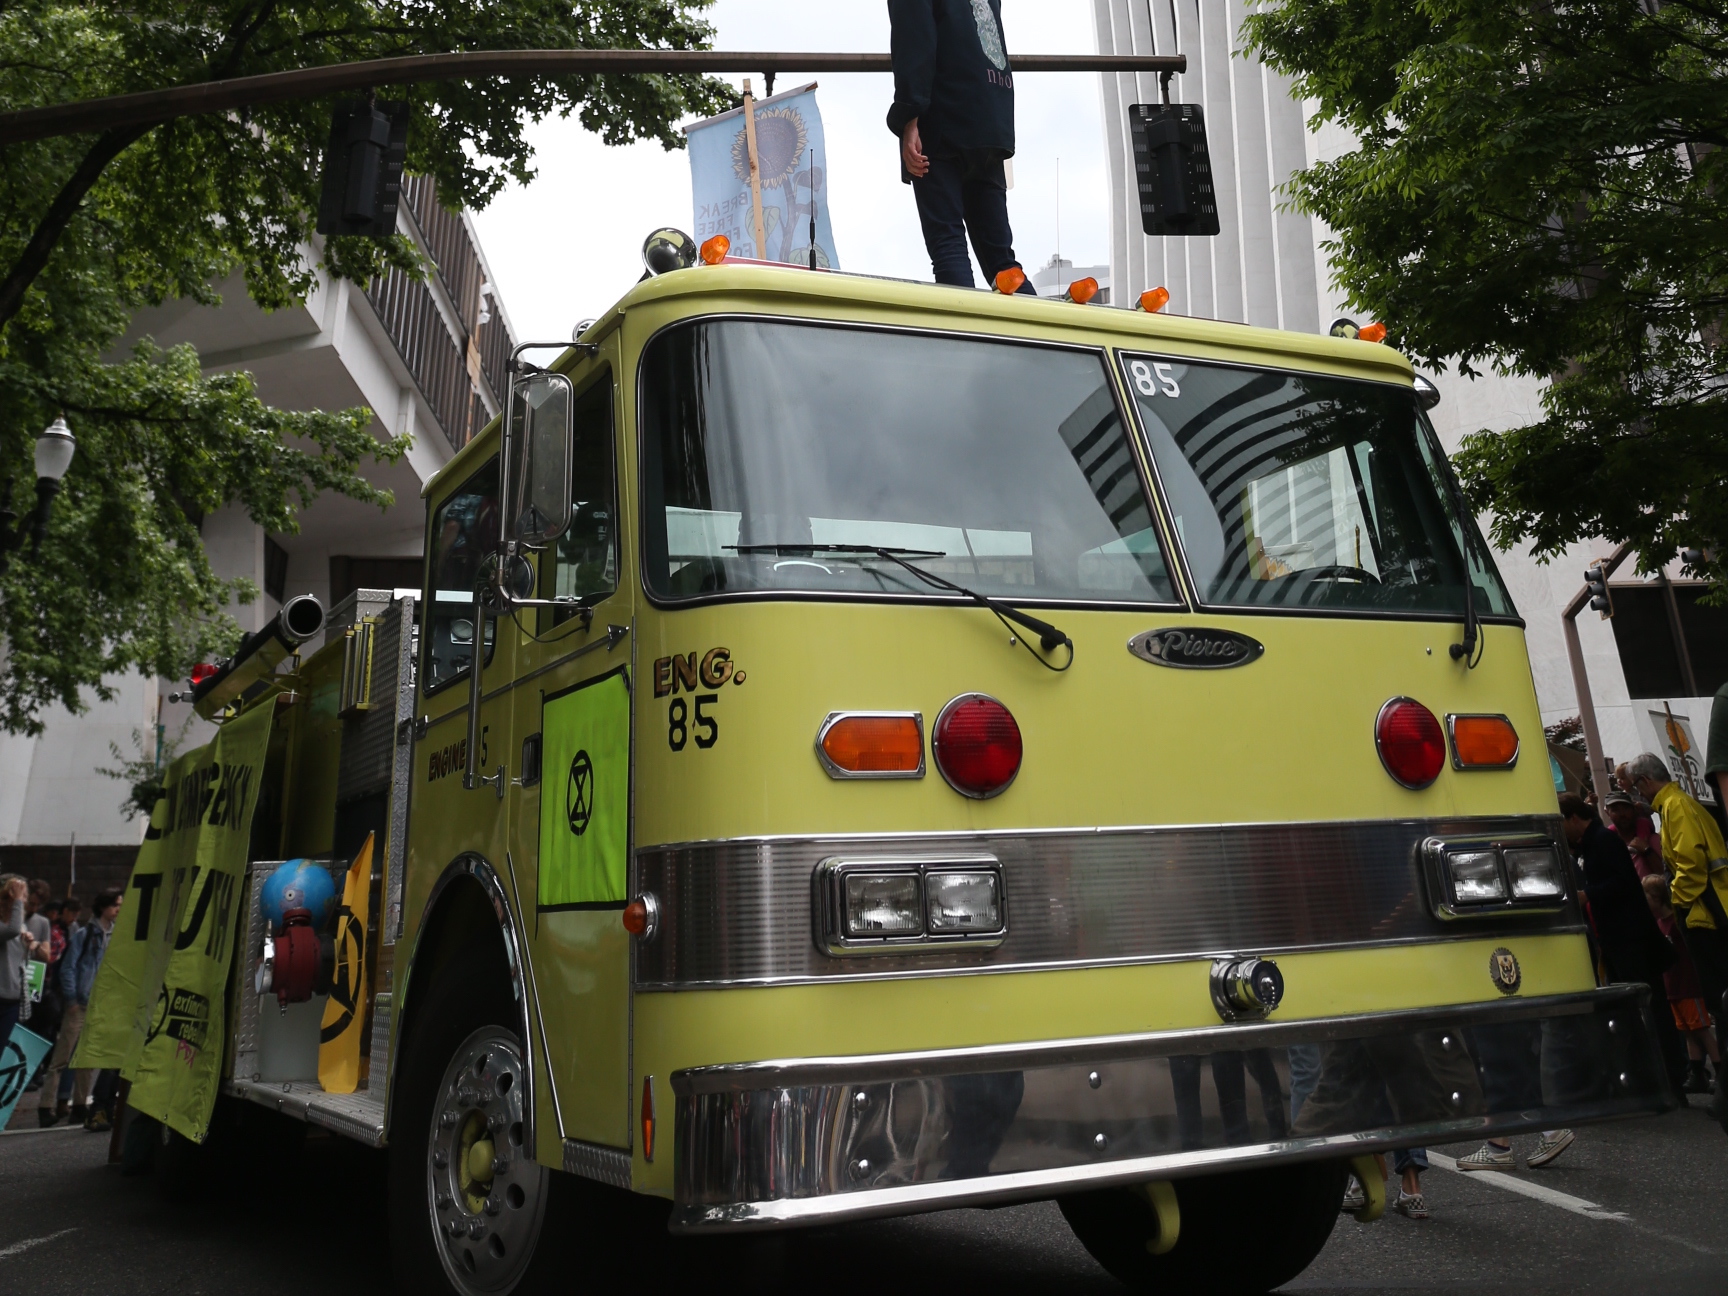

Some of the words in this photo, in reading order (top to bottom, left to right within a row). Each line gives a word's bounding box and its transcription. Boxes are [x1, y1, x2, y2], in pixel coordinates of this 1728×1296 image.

[1130, 360, 1180, 398] 85
[1161, 631, 1234, 661] Pierce
[653, 646, 747, 699] ENG.
[668, 693, 718, 752] 85
[428, 738, 467, 782] ENGINE
